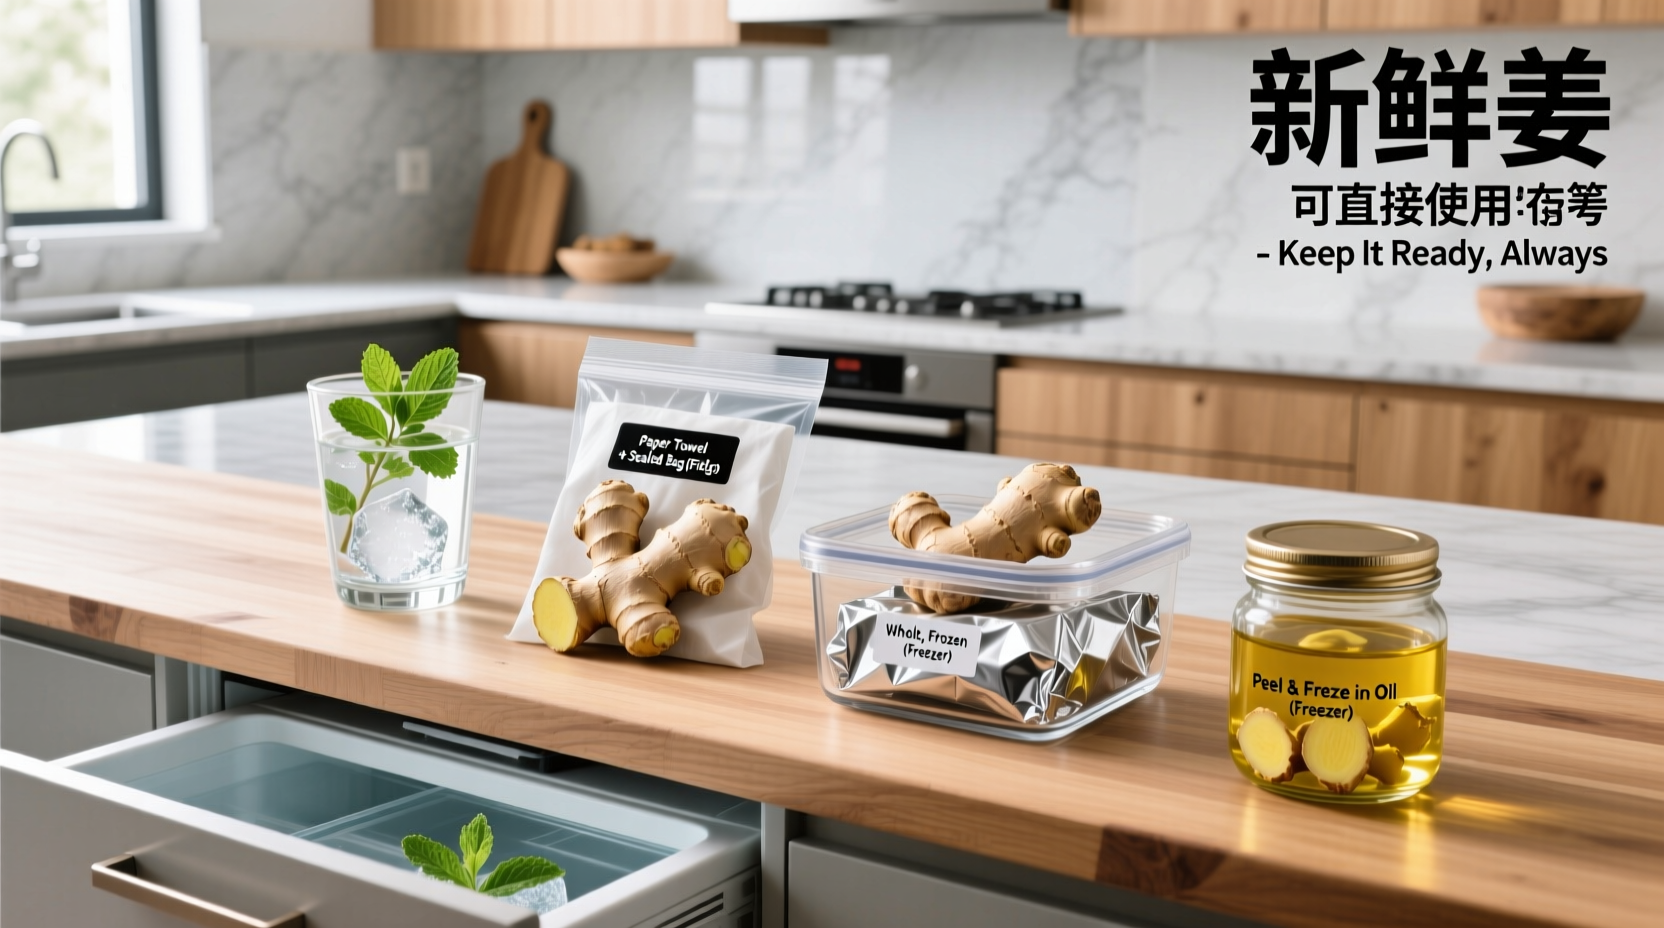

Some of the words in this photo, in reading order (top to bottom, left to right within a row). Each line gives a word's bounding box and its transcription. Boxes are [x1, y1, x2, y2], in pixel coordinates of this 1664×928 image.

[639, 435, 671, 450] Paper
[674, 438, 708, 454] Towel
[903, 643, 952, 664] (Freezer)
[1252, 672, 1283, 693] Peel
[1287, 679, 1299, 696] &
[1304, 681, 1350, 699] Freze
[1355, 684, 1370, 700] in
[1289, 700, 1353, 722] (Freezer)
